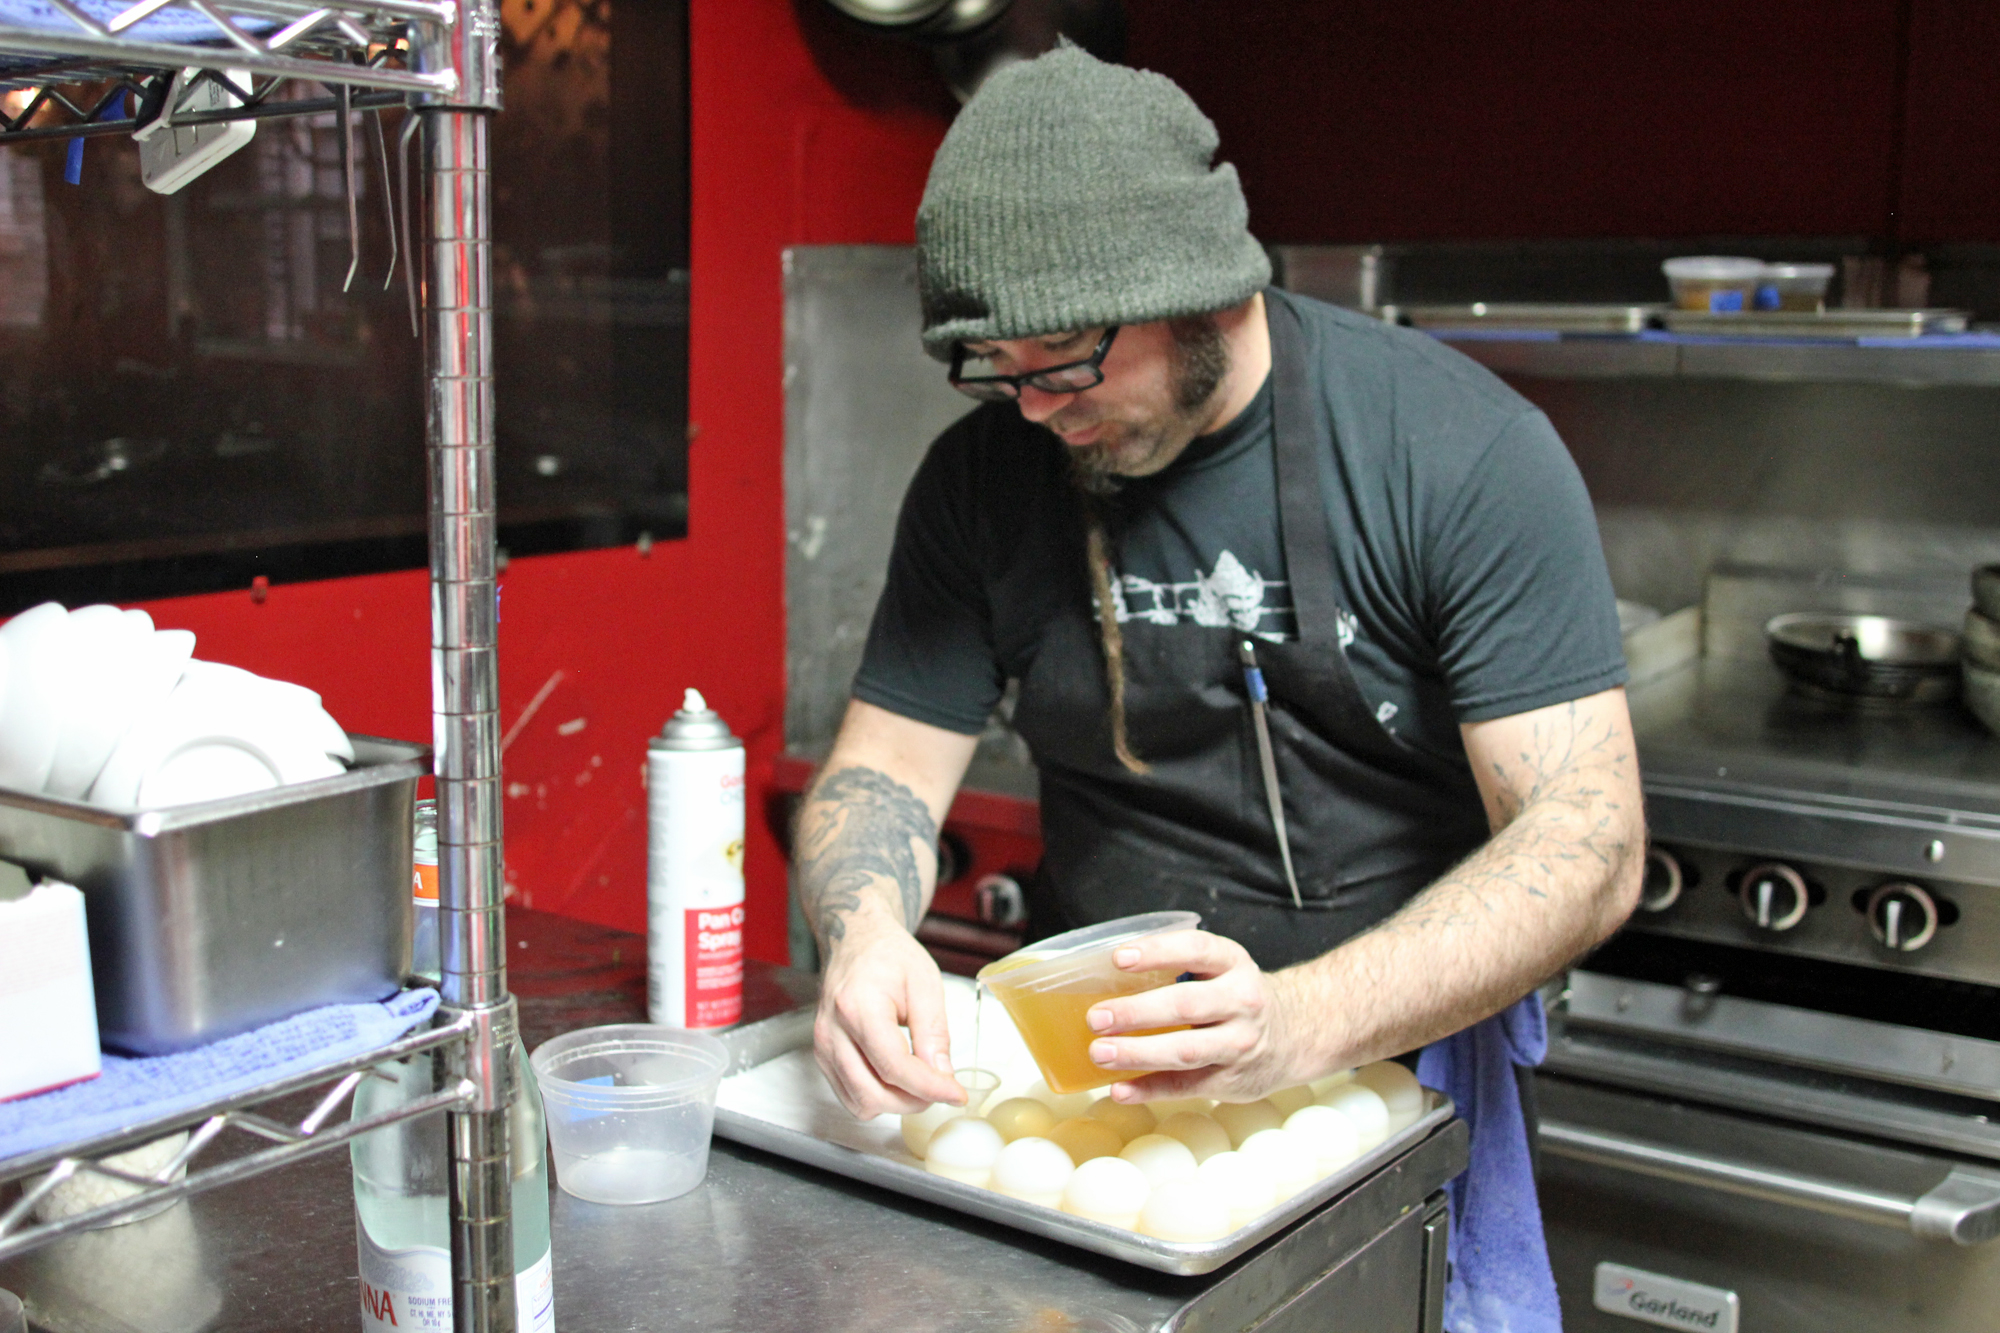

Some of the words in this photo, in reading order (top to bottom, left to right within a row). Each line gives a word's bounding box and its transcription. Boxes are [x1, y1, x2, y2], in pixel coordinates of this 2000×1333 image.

[698, 912, 731, 930] Pan
[408, 1296, 436, 1306] SODIUM
[1629, 1290, 1719, 1328] Garland
